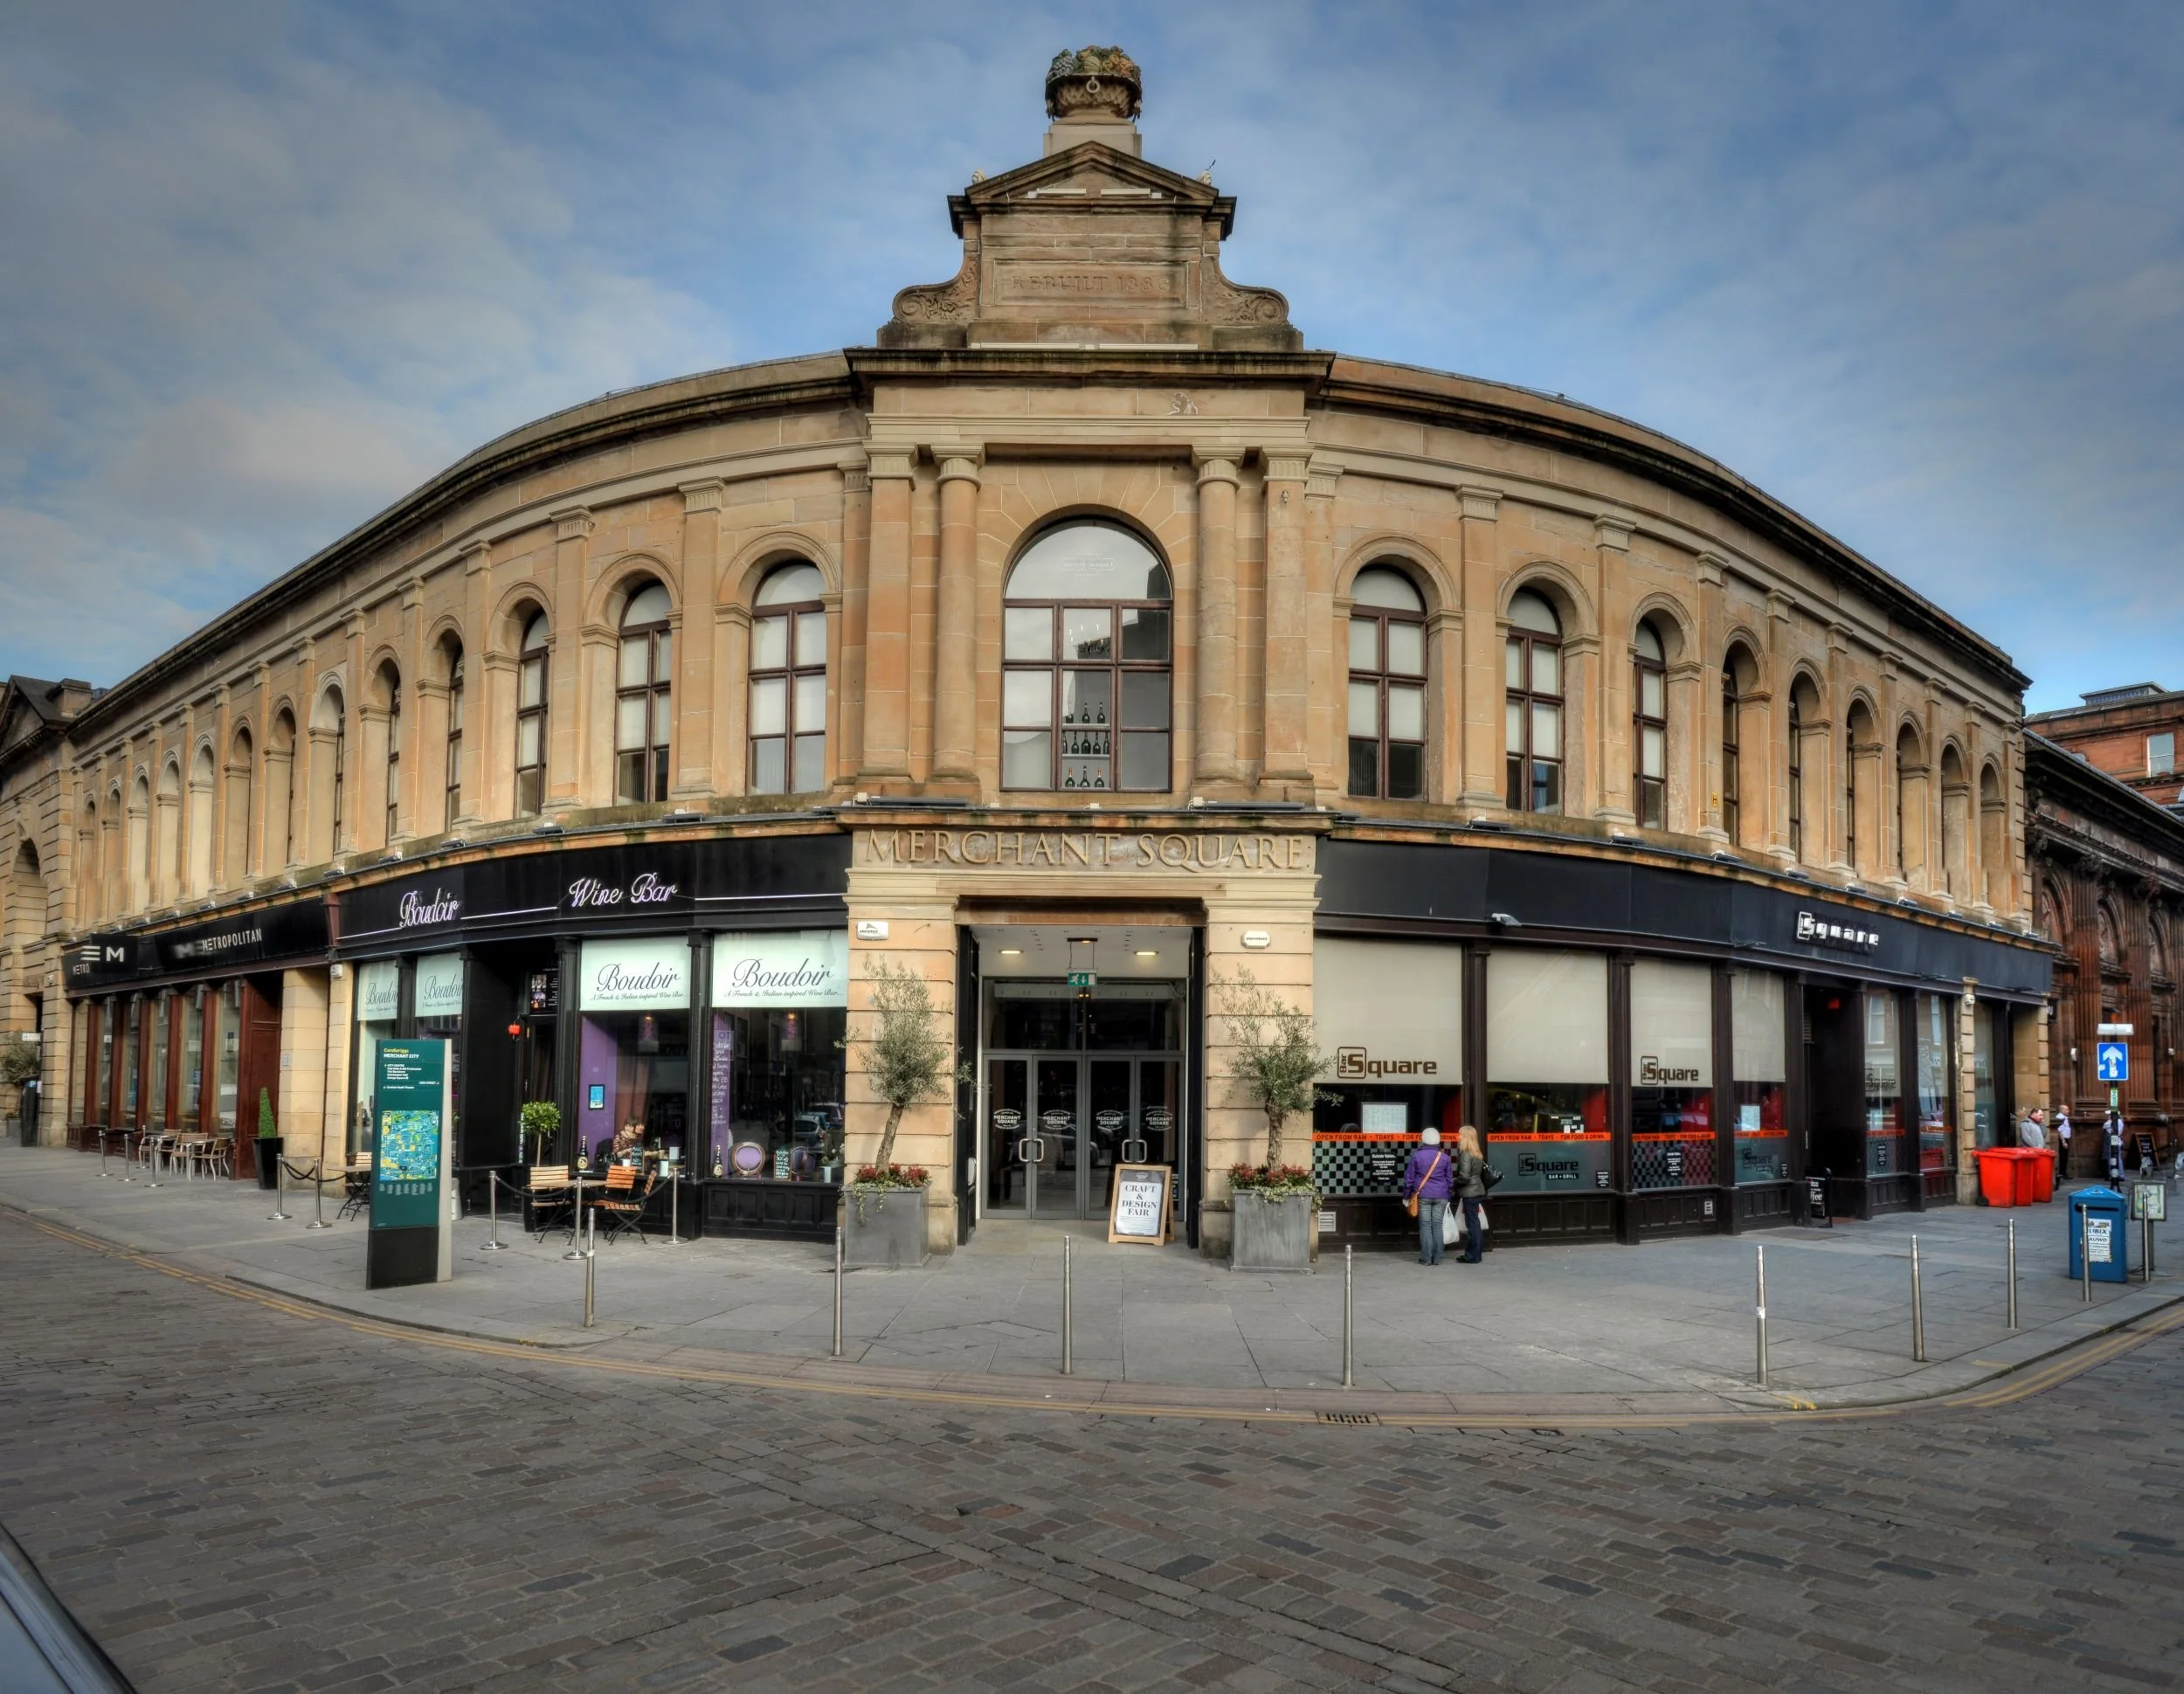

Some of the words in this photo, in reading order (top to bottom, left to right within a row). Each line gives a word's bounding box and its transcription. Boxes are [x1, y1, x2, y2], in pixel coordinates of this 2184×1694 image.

[865, 828, 1122, 866] MERCHANT
[1137, 833, 1303, 873] SQUARE
[569, 876, 623, 907] Wine
[631, 873, 678, 904] Bar
[399, 888, 460, 928] Boudoir
[202, 928, 262, 951] METROPOLITAN
[1803, 916, 1879, 946] Square
[73, 963, 90, 976] METRO
[597, 961, 681, 992] Boudoir
[732, 958, 835, 988] Boudoir
[365, 980, 398, 1006] Boudoi
[424, 972, 463, 1000] Boudoi
[784, 989, 807, 999] inspired
[1348, 1054, 1437, 1078] Square
[1647, 1062, 1699, 1084] Square
[1524, 1158, 1579, 1174] Square
[1122, 1200, 1158, 1209] DESIGN
